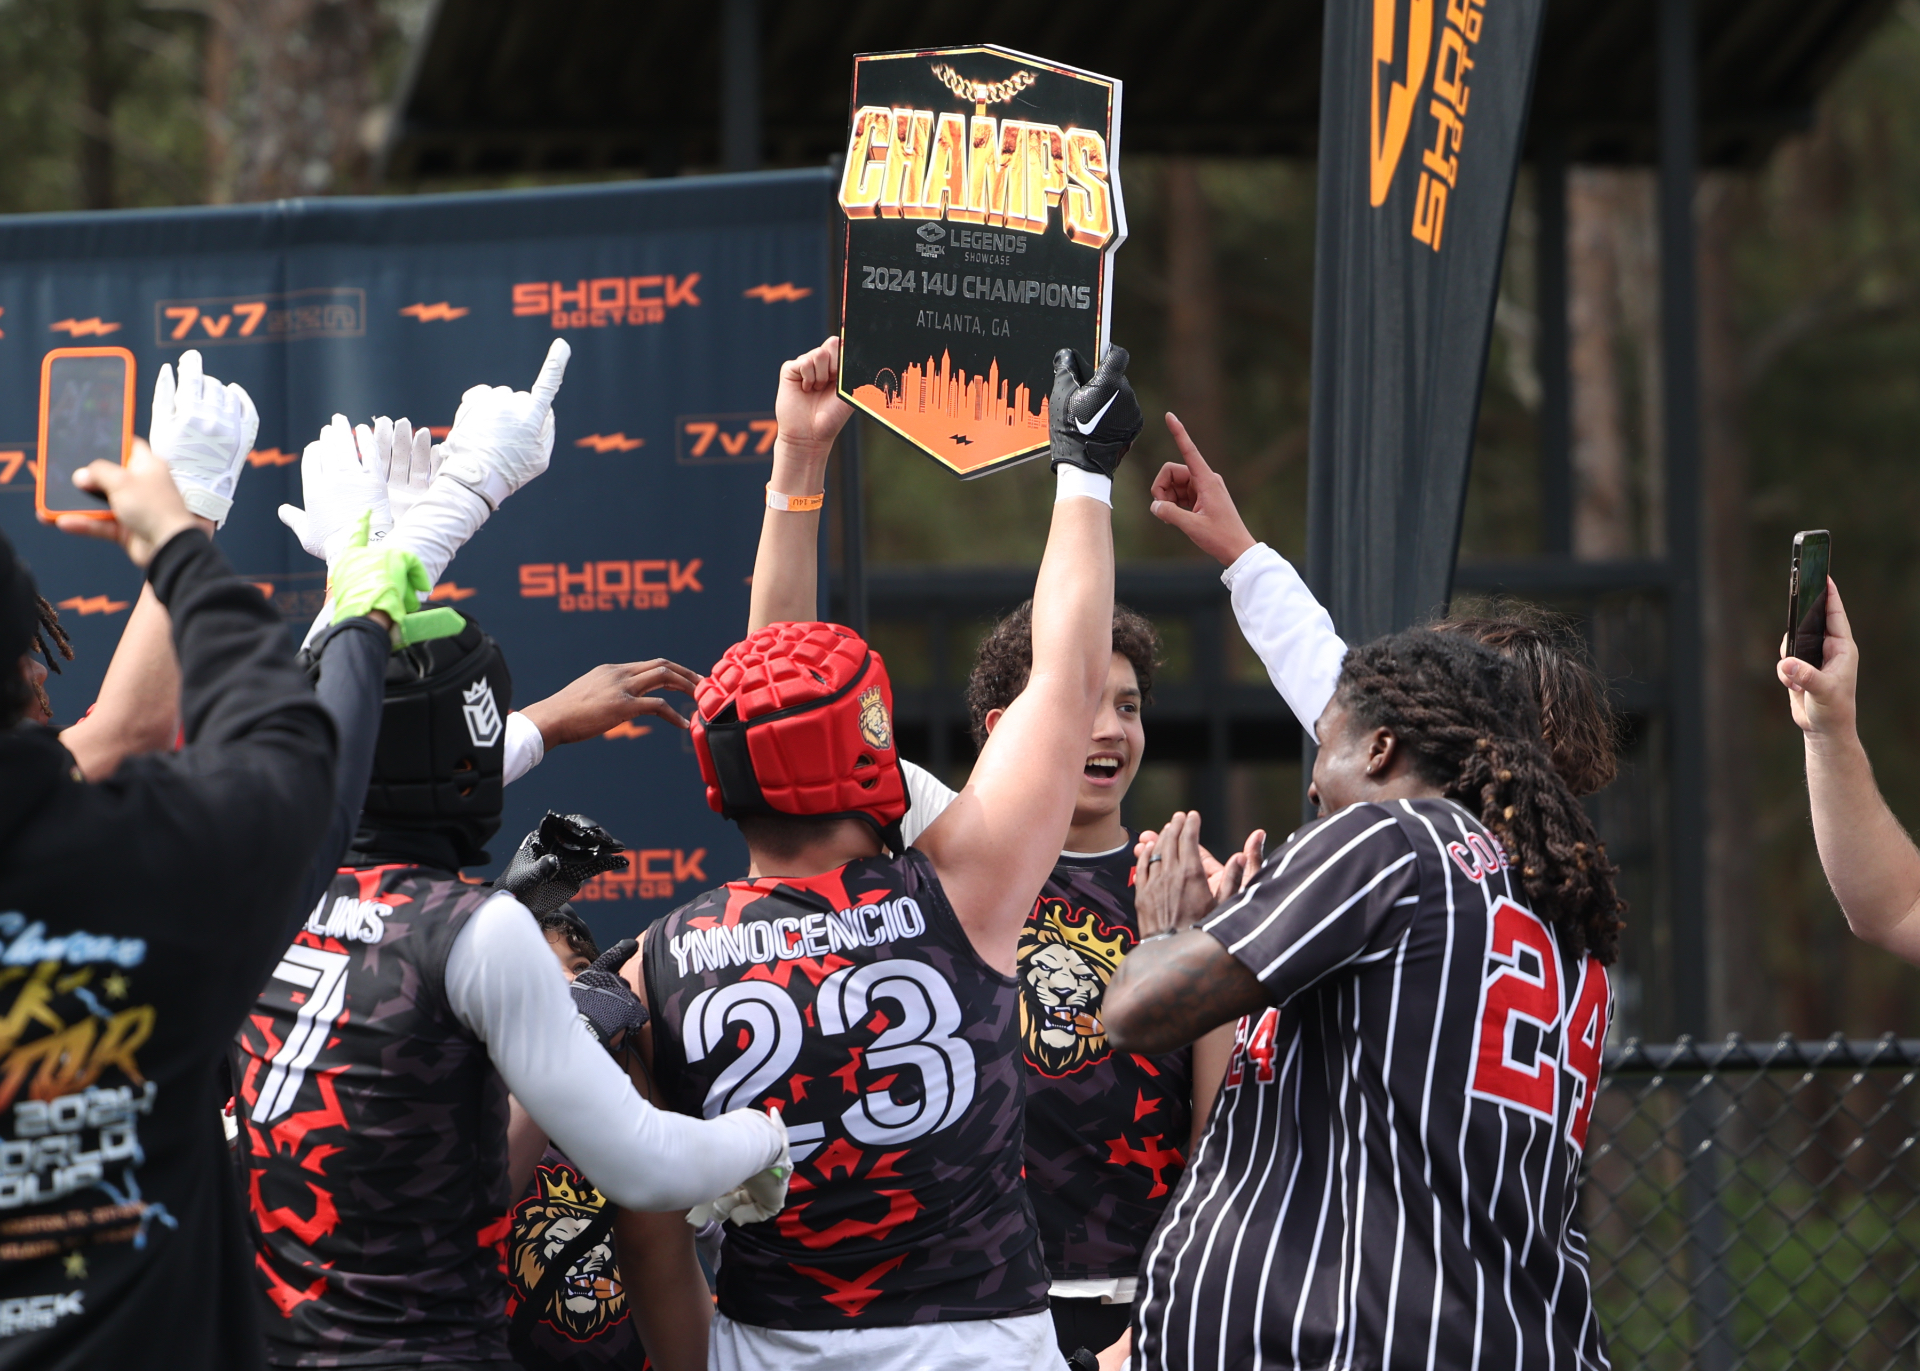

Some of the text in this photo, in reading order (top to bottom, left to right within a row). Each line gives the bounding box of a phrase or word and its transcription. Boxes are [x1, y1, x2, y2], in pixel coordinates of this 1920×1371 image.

[838, 105, 1114, 250] CHAMPS
[915, 243, 945, 255] SHOCK
[950, 229, 1027, 253] LEGENDS
[964, 251, 1010, 265] SHOWCASE
[513, 272, 700, 316] SHOCK
[862, 265, 1091, 310] 2024 14U CHAMPIONS
[165, 302, 267, 340] 7v7
[551, 307, 665, 329] DOCTOR
[916, 309, 1011, 337] ATLANTA, GA
[685, 420, 778, 457] 7v7
[519, 559, 703, 597] SHOCK
[559, 593, 669, 611] DOCTOR
[590, 848, 707, 882] OCK
[302, 891, 393, 944] LINS
[670, 896, 926, 978] YNNOCENCIO
[250, 944, 350, 1124] 7
[1465, 895, 1612, 1158] 24
[682, 958, 976, 1164] 23
[1225, 1006, 1281, 1091] 24
